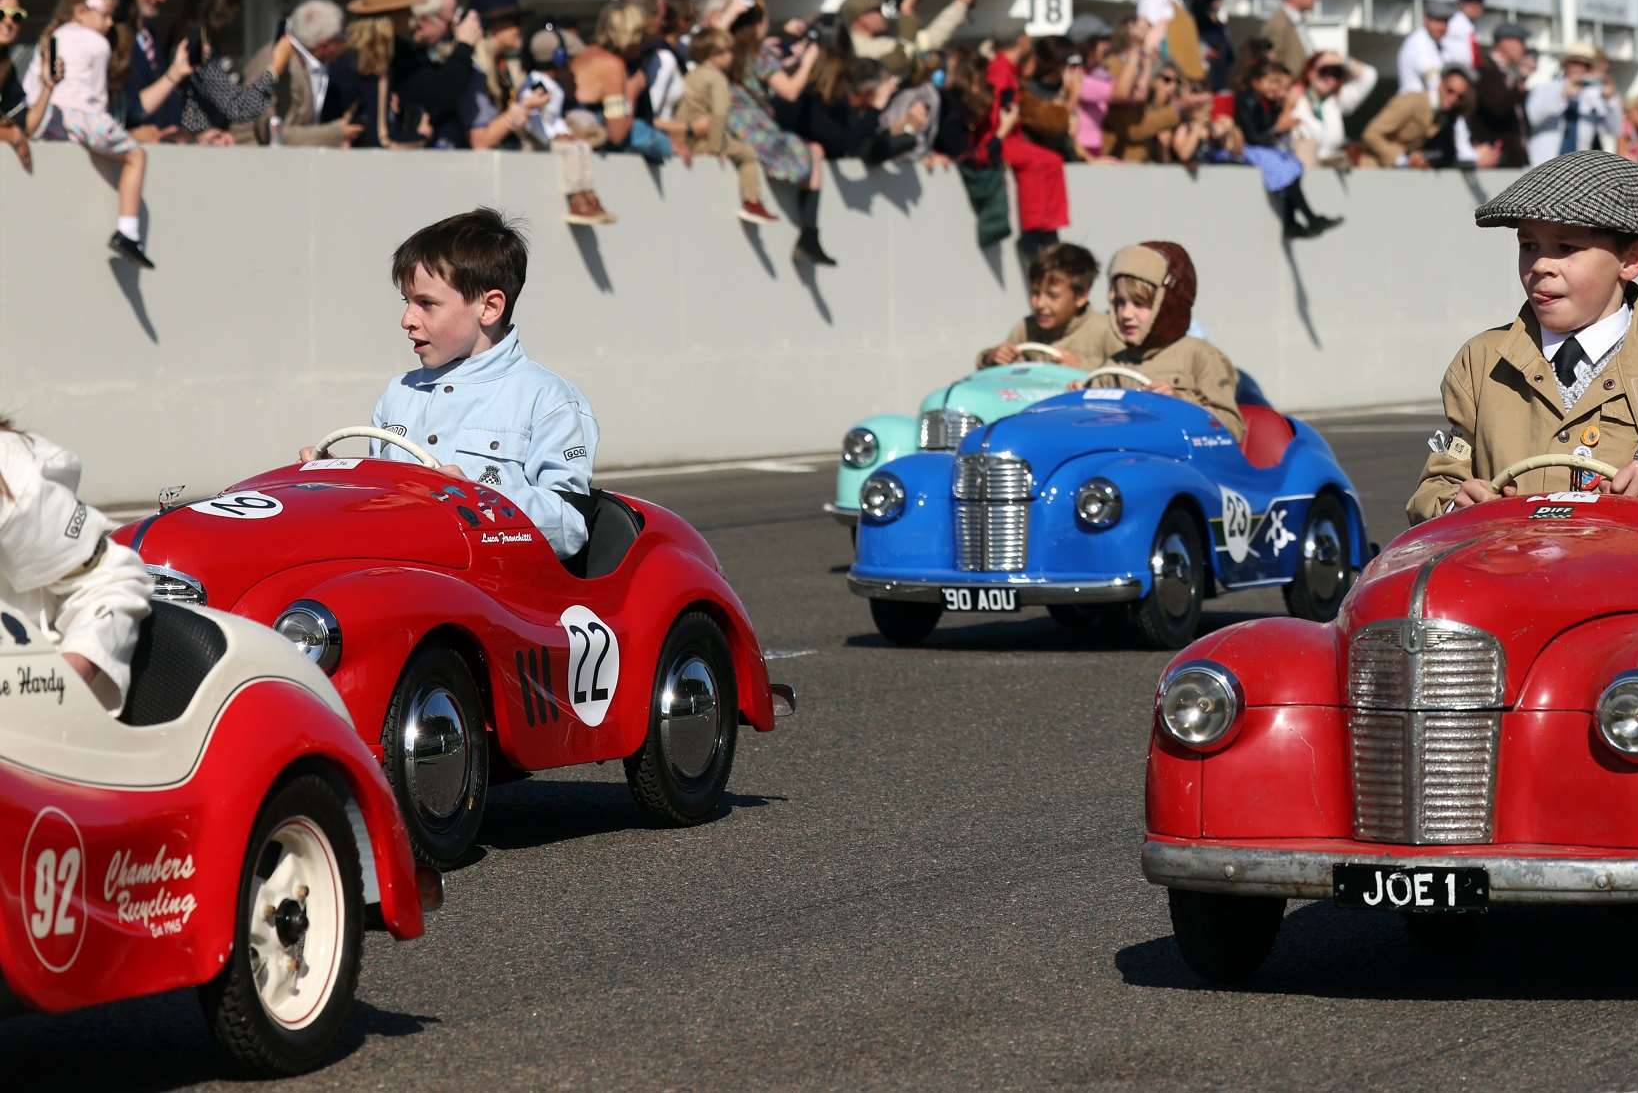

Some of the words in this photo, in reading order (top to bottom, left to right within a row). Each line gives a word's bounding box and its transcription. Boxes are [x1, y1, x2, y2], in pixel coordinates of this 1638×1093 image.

[1226, 494, 1249, 539] 23
[1536, 506, 1574, 514] DIFF
[481, 532, 500, 543] Luca
[944, 588, 972, 611] 90
[569, 621, 609, 705] 22
[17, 666, 66, 706] Hardy
[31, 846, 81, 940] 92
[104, 843, 196, 902] Chambers
[1362, 870, 1435, 907] JOE
[1444, 872, 1456, 907] 1
[116, 886, 198, 928] Recycling
